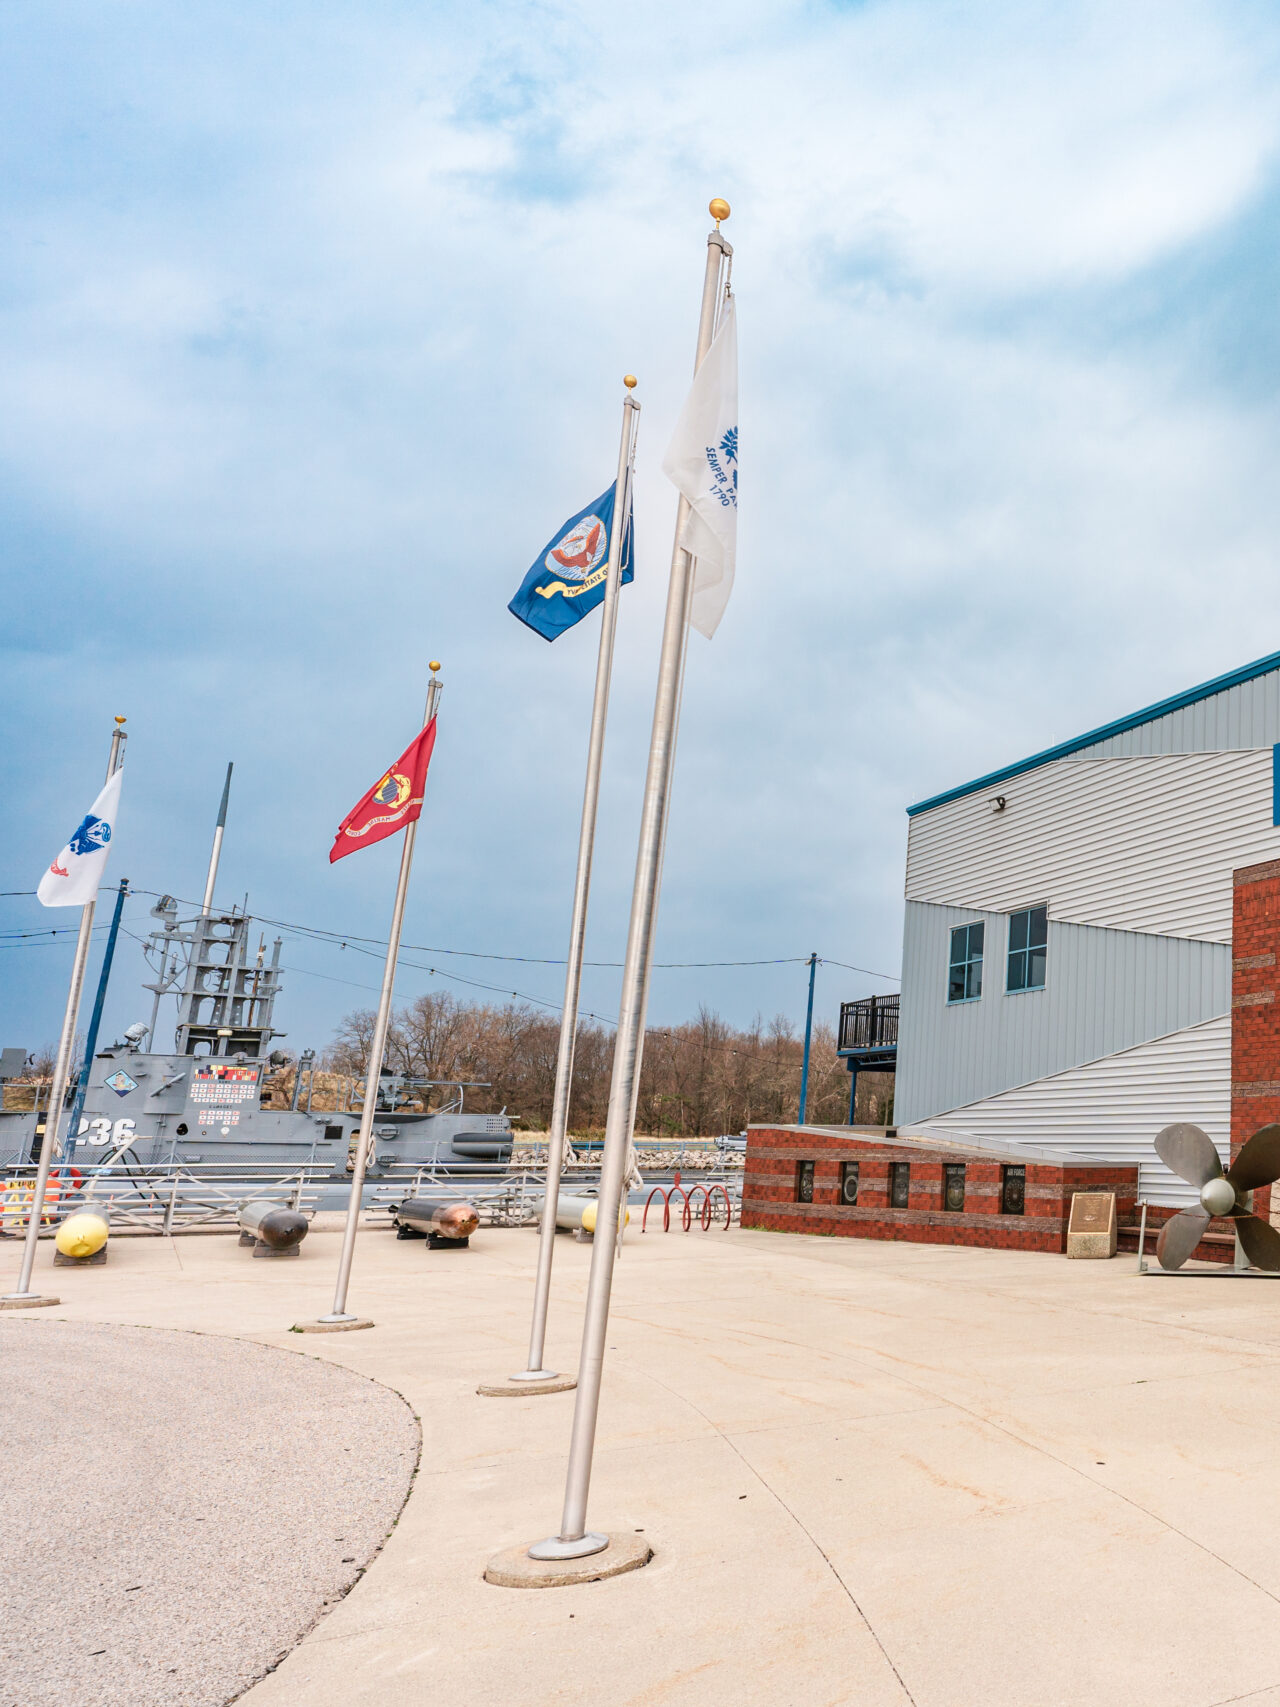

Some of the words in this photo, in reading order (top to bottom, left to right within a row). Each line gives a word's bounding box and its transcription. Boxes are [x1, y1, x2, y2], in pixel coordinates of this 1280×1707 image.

[706, 446, 728, 485] SEMPER
[709, 484, 730, 507] 1790
[67, 1118, 136, 1147] 236
[1013, 1168, 1026, 1176] FORCE
